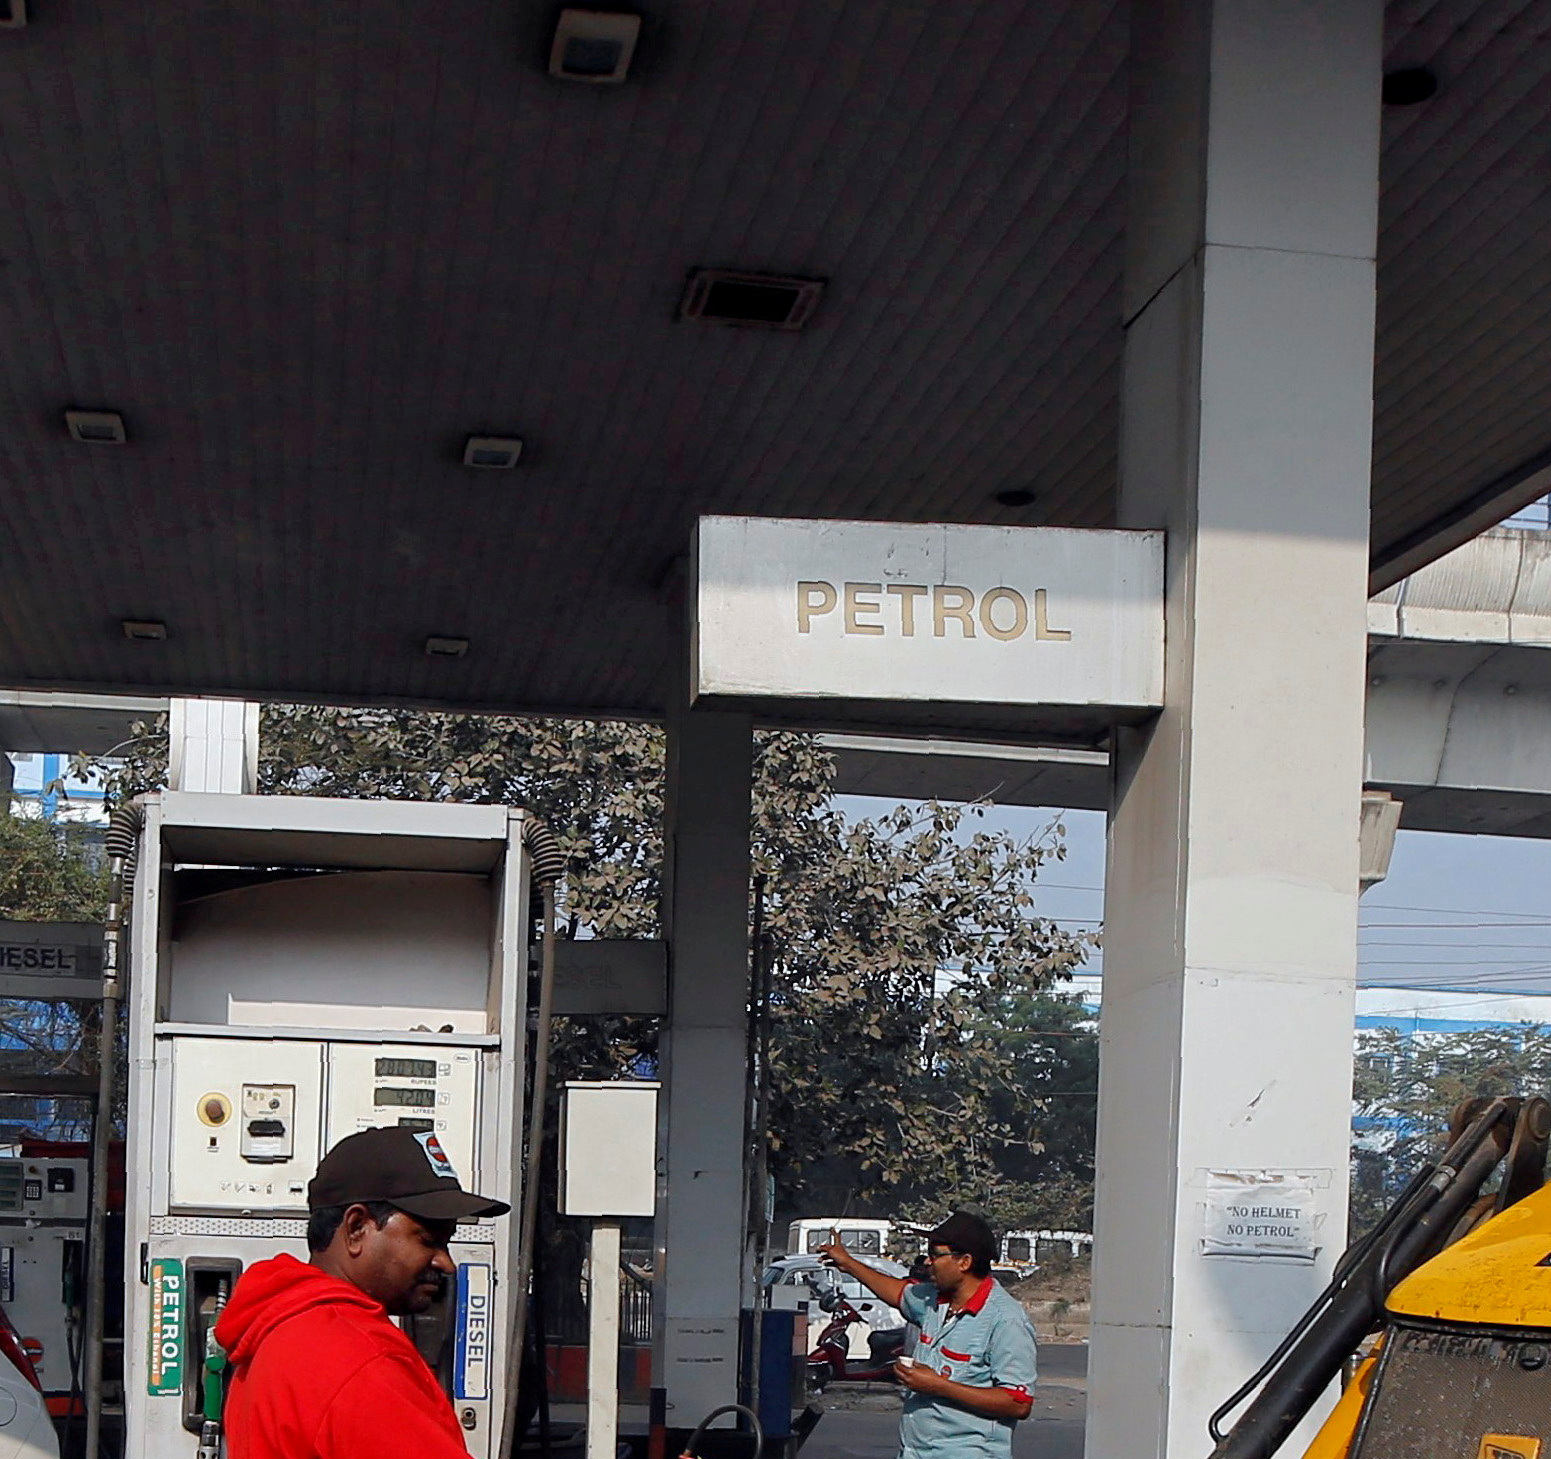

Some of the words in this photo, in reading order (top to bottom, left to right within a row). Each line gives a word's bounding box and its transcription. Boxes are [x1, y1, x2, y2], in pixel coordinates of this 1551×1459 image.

[796, 580, 1072, 642] PETROL
[1227, 1224, 1243, 1236] NO
[1252, 1206, 1301, 1219] HELMET
[162, 1275, 180, 1376] PETROL
[467, 1295, 486, 1368] DIESEL
